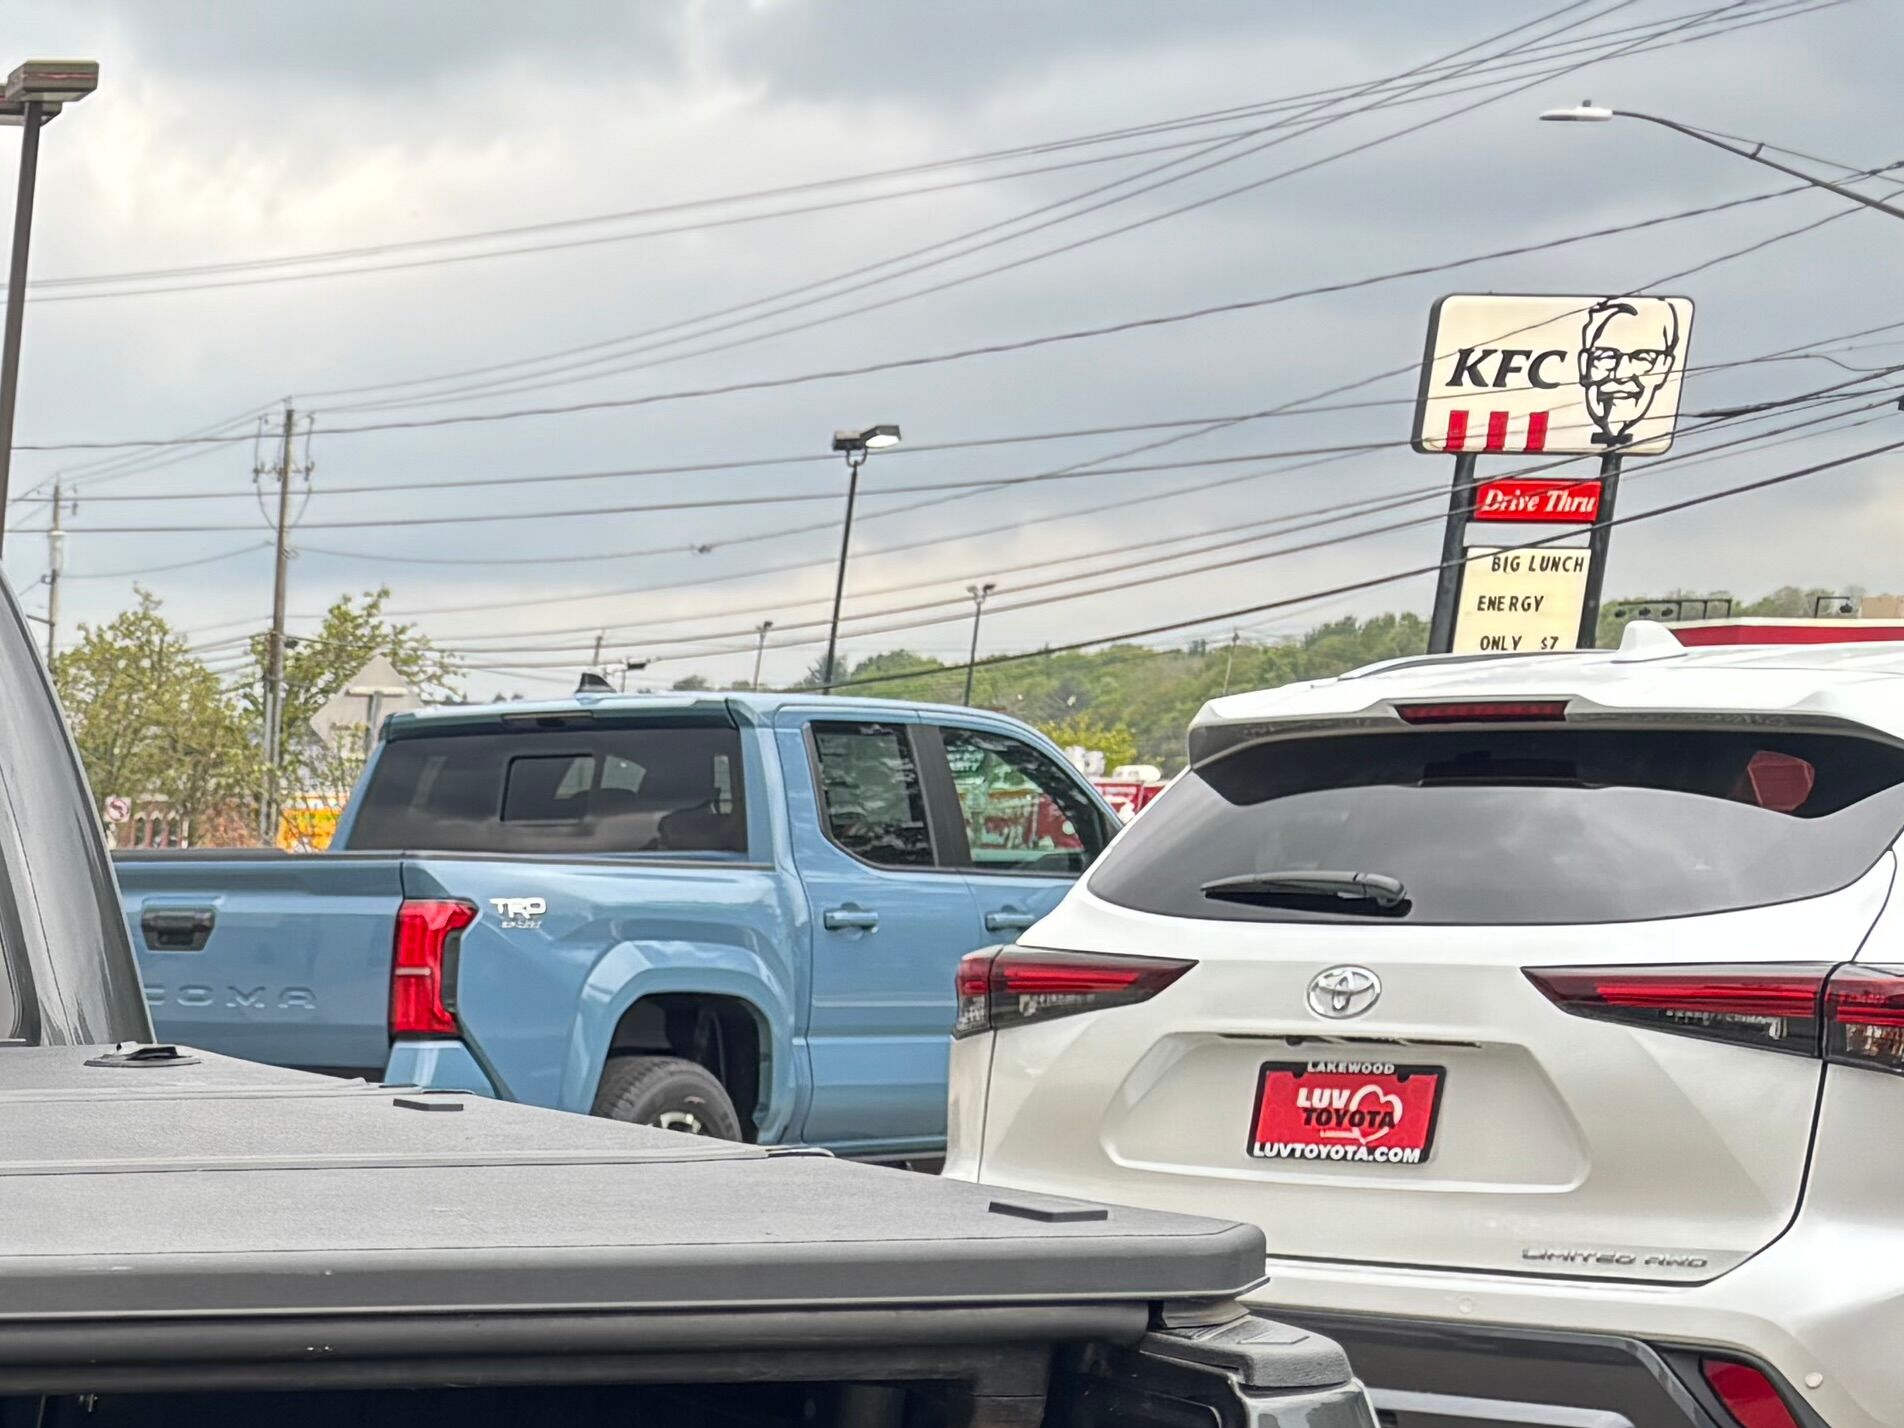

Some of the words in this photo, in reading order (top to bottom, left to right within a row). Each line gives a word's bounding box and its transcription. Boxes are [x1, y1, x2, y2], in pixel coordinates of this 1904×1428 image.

[1445, 349, 1567, 389] KFC
[1481, 488, 1540, 512] Drive
[1544, 489, 1596, 513] Thru
[1492, 556, 1521, 573] BIG
[1528, 555, 1584, 573] LUNCH
[1477, 595, 1544, 612] ENERGY
[1480, 635, 1523, 651] ONLY
[1540, 636, 1559, 650] $7
[488, 897, 546, 919] TRD
[144, 984, 316, 1009] COMA
[1307, 1061, 1395, 1075] LAKEWOOD
[1297, 1087, 1351, 1109] LUV
[1302, 1108, 1396, 1130] TOYOTA
[1253, 1141, 1421, 1163] LUVTOYOTA.COM
[1521, 1248, 1636, 1265] LIMITED
[1644, 1253, 1708, 1268] AWD
